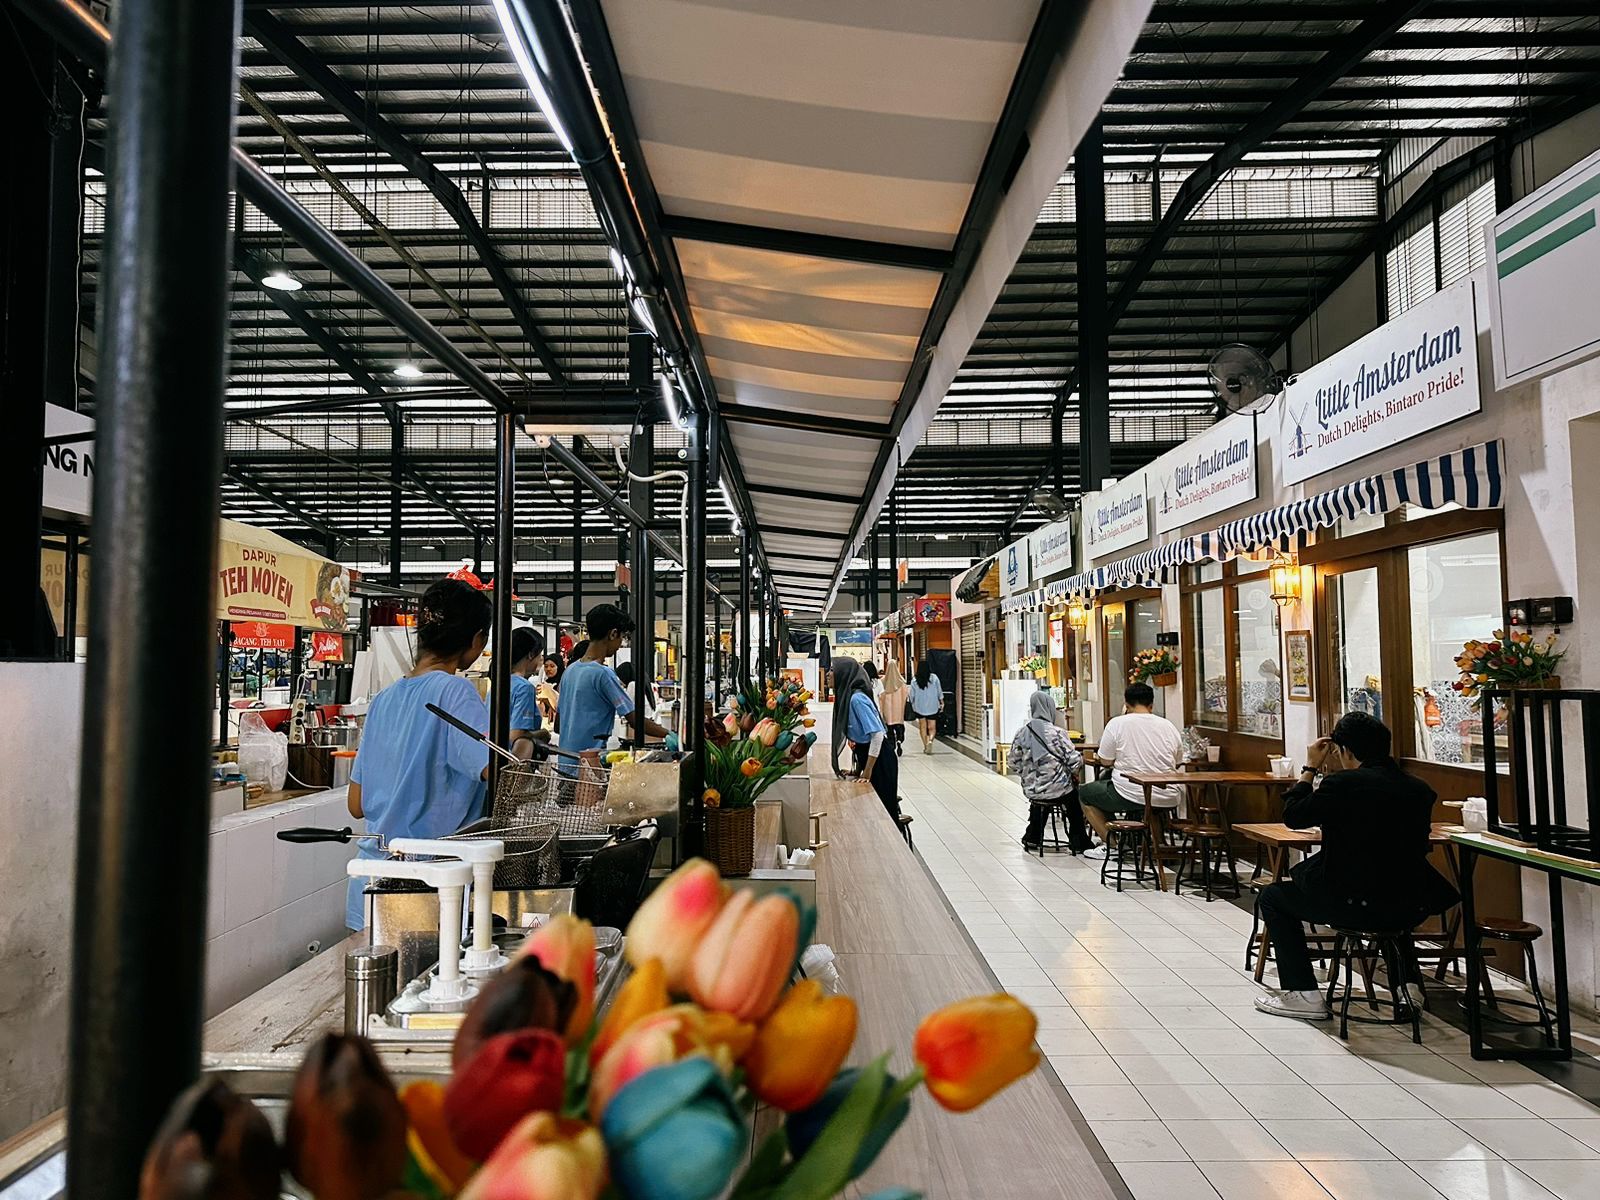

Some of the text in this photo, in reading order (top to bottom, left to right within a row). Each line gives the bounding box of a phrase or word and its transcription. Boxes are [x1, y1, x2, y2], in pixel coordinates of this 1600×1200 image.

[1315, 325, 1461, 430] Little Amsterdam
[1317, 366, 1465, 448] Dutch Delights, Bintaro Pride!
[1174, 439, 1249, 497] Little Amsterdam
[219, 566, 293, 608] TEH MOYEN
[242, 549, 277, 567] DAPUR
